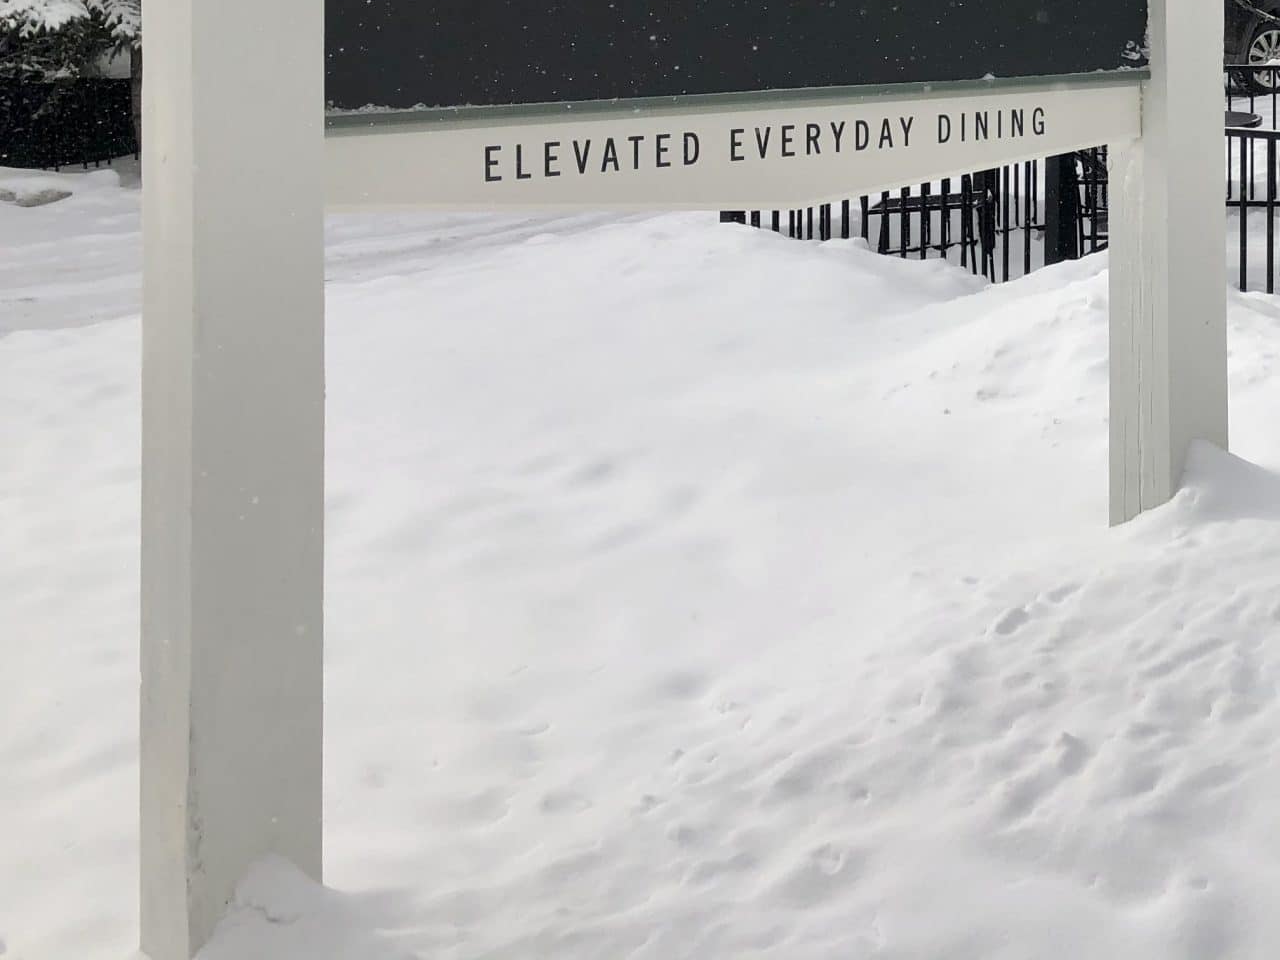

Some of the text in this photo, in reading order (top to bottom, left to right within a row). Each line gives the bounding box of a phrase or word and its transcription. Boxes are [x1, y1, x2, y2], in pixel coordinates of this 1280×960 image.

[484, 107, 1046, 183] ELEVATED EVERYDAY DINING
